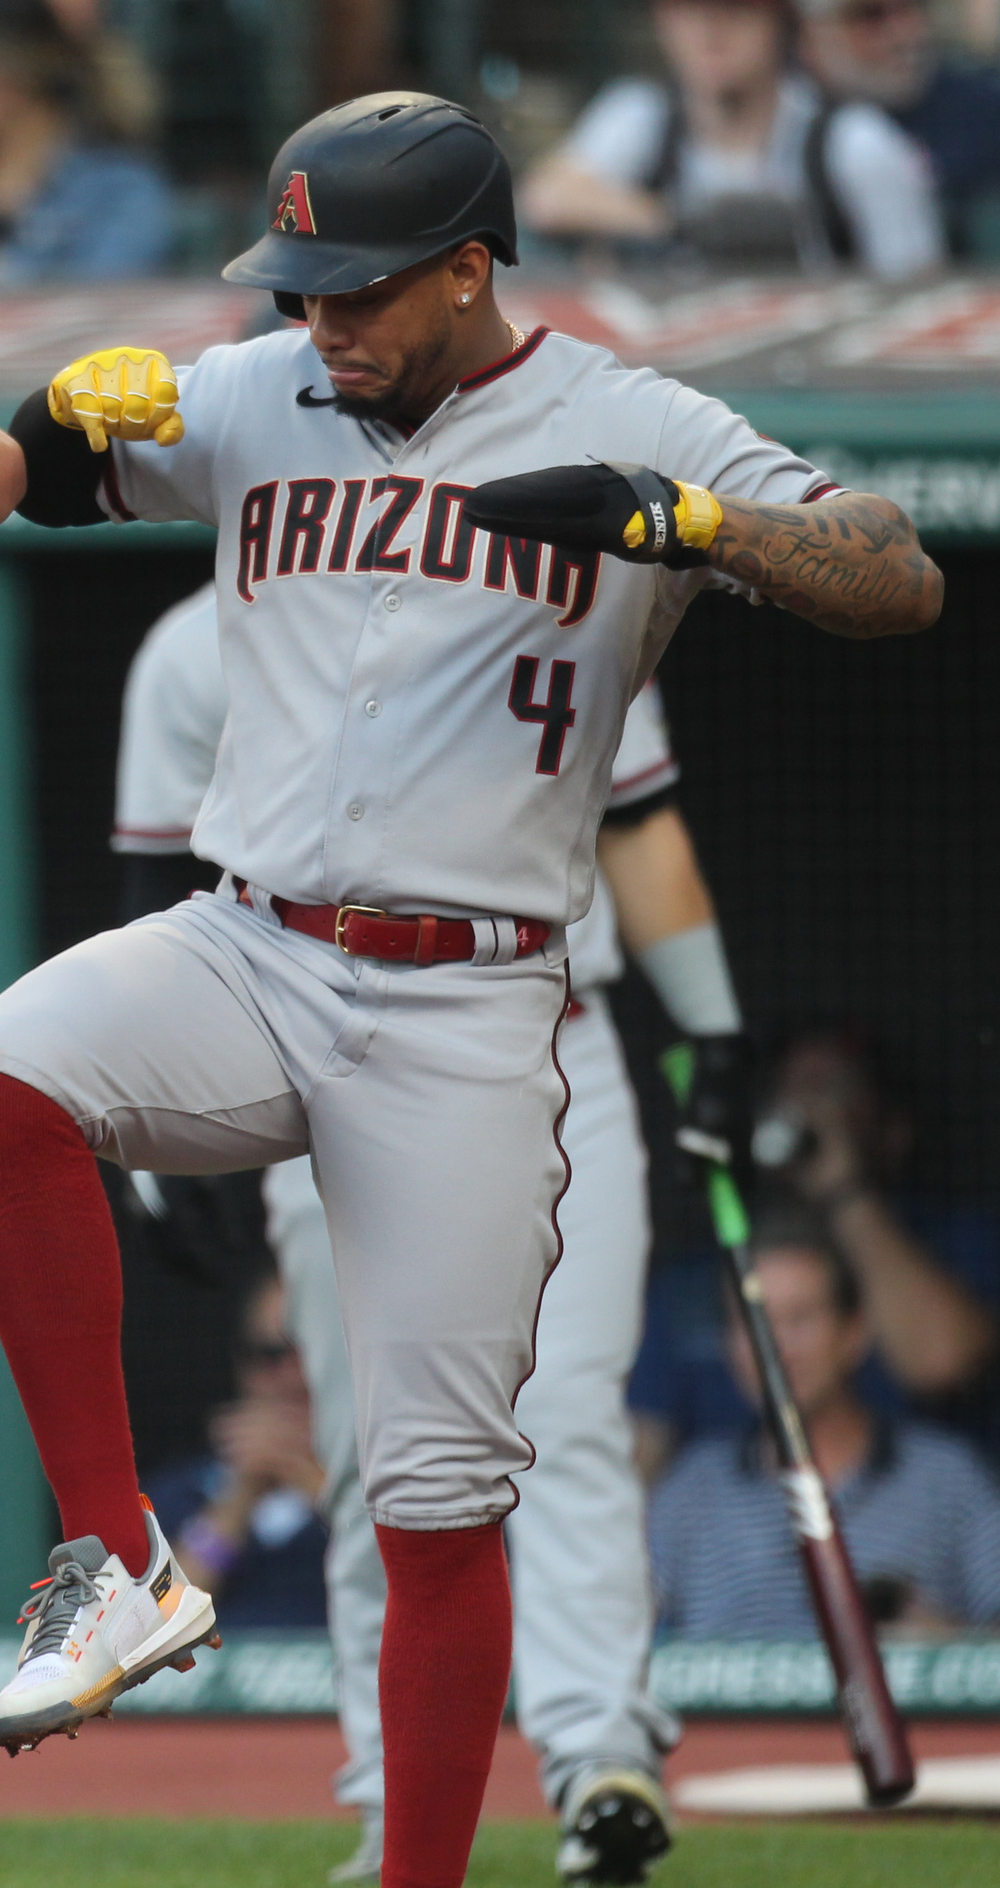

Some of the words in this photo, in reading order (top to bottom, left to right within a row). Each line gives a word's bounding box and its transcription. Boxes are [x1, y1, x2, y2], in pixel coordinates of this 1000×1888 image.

[764, 530, 901, 606] Family
[507, 654, 577, 777] 4
[516, 926, 529, 947] 4
